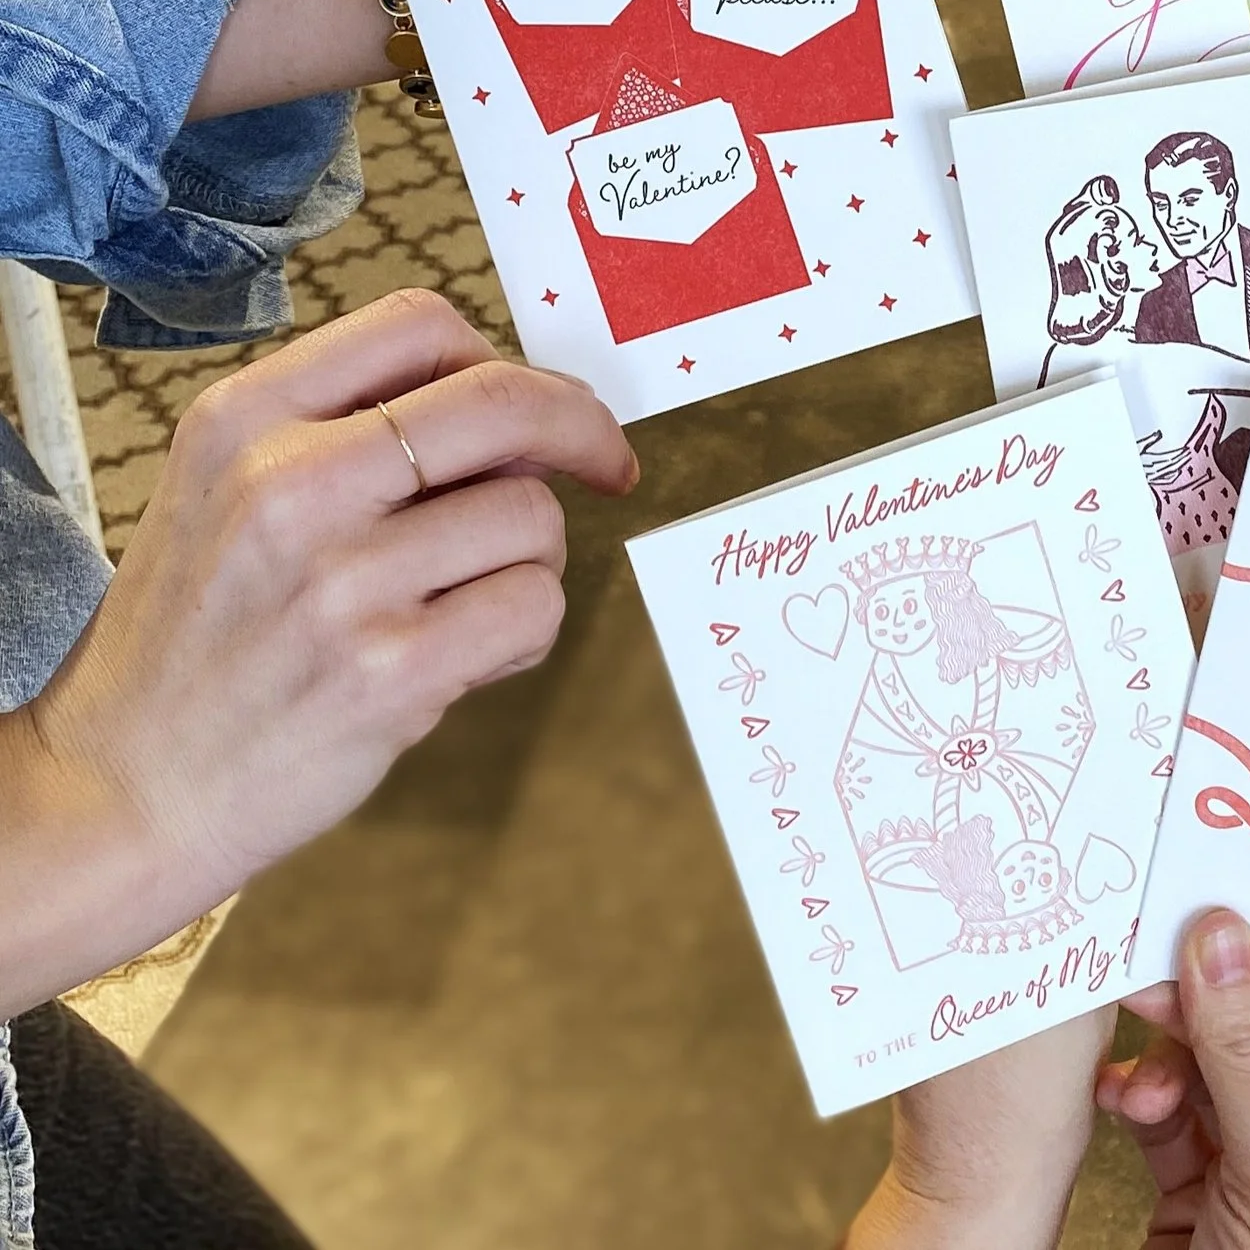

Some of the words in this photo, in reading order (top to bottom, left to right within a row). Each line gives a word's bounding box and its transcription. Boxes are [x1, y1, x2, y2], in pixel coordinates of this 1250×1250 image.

[600, 147, 741, 222] Valentine?
[607, 152, 635, 175] be
[645, 142, 681, 169] my
[711, 529, 818, 585] Happy
[825, 468, 993, 543] Valentine's
[995, 434, 1065, 488] Day
[854, 1050, 876, 1068] TO
[884, 1032, 918, 1056] THE
[930, 989, 1018, 1042] Queen
[1026, 965, 1053, 1008] of
[1059, 936, 1117, 992] My
